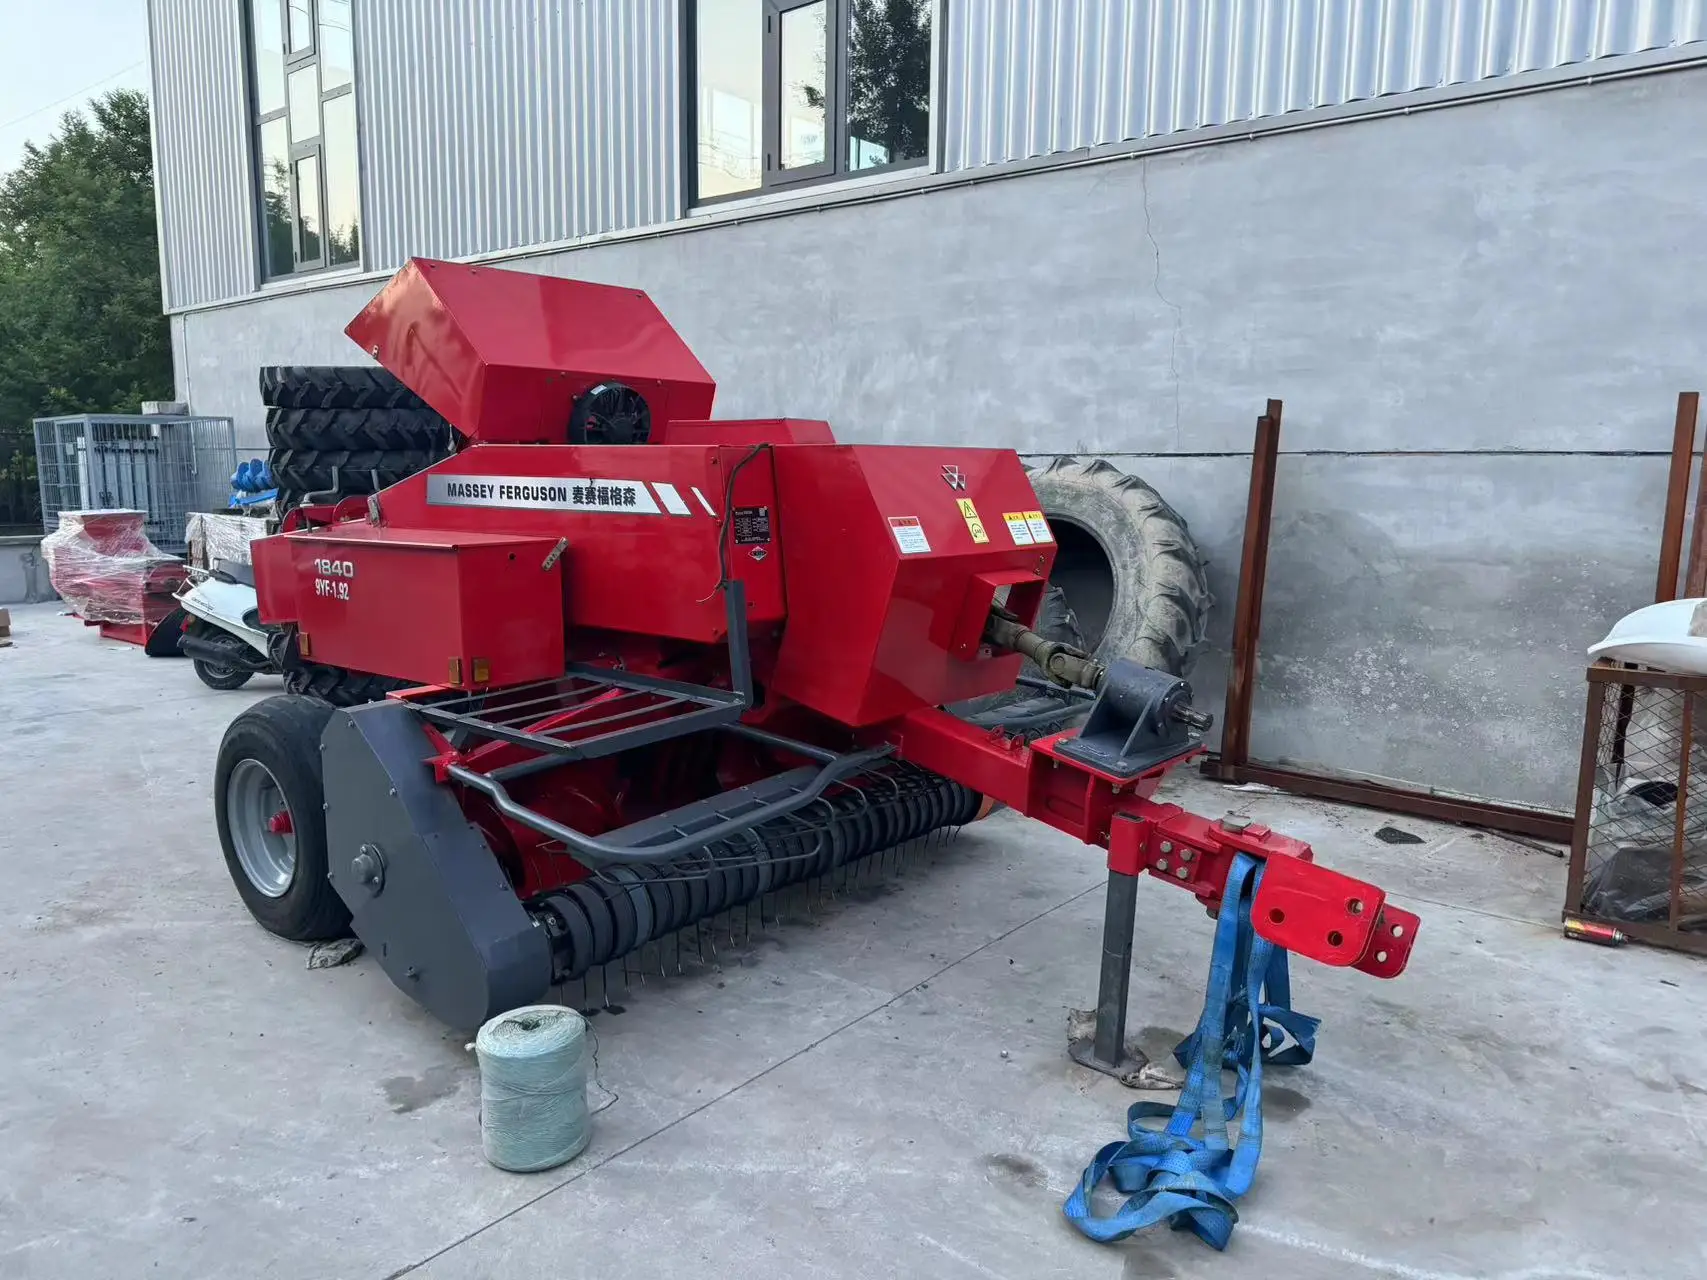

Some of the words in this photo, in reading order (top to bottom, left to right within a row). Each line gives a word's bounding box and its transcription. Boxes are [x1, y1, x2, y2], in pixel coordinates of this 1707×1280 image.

[447, 482, 494, 499] MASSEY
[499, 485, 567, 502] FERGUSON
[572, 485, 636, 507] 麦赛福格森
[314, 558, 354, 578] 1840
[315, 578, 349, 600] 9YF-1.92
